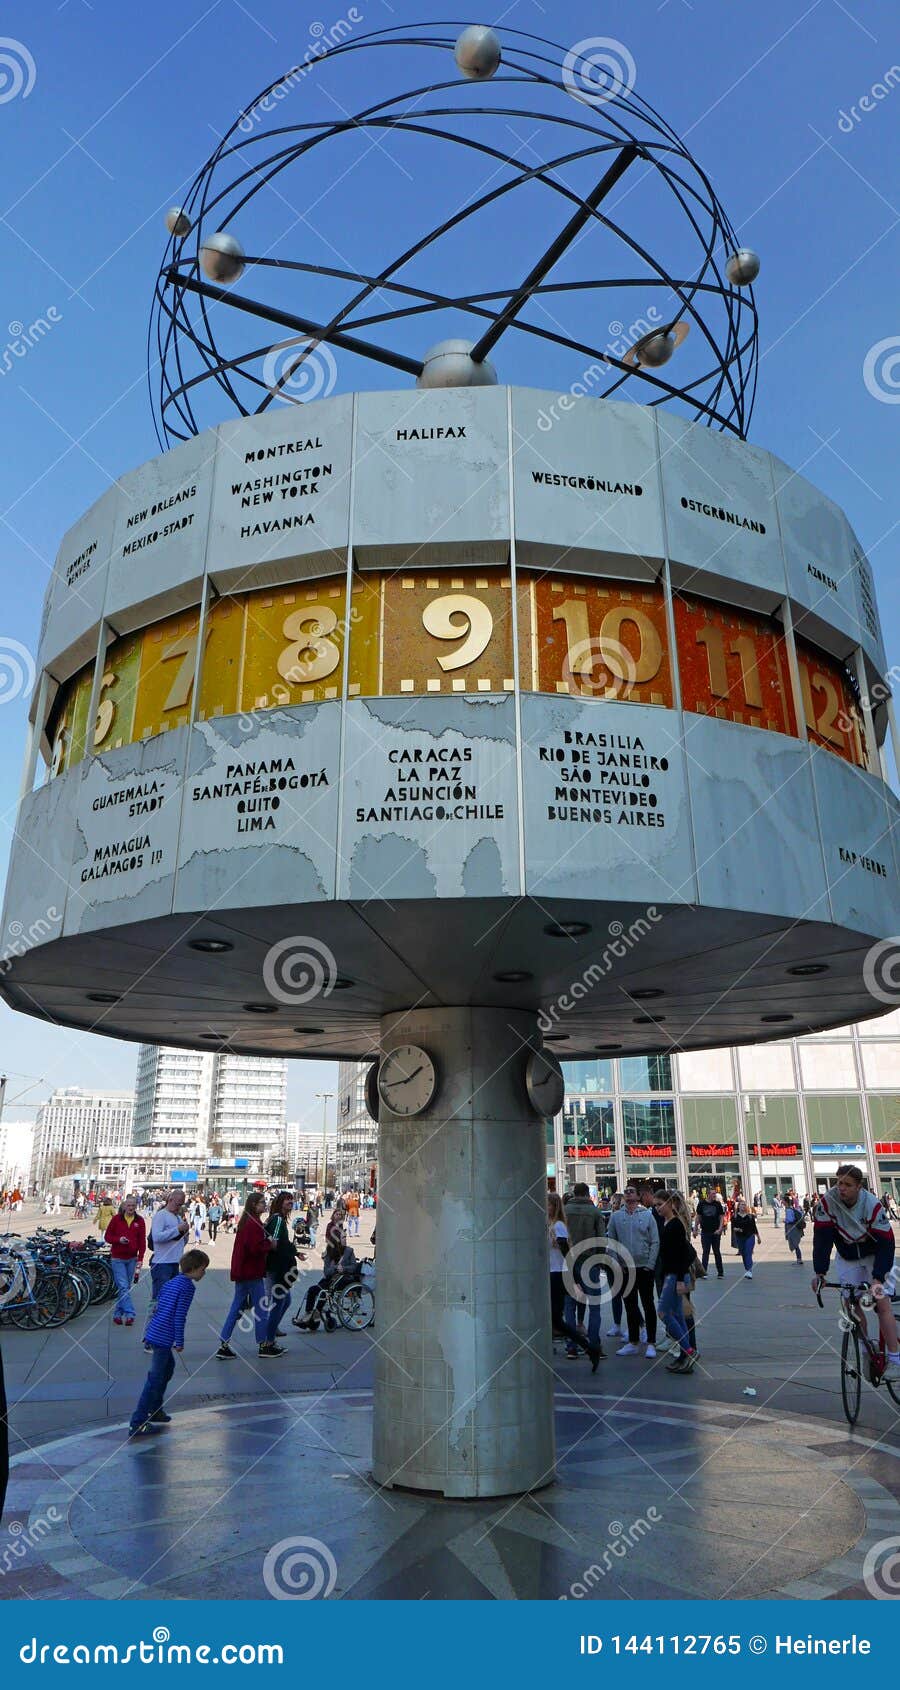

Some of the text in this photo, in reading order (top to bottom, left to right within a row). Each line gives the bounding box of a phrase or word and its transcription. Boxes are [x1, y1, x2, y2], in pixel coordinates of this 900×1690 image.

[397, 427, 466, 440] HALIFAX
[245, 437, 322, 463] MONTREAL
[231, 464, 333, 495] WASHINGTON
[532, 471, 643, 496] WESTGRÖNLAND
[127, 485, 196, 528] NEW ORLEANS
[242, 482, 319, 508] NEW YORK
[241, 513, 315, 538] HAVANNA
[680, 496, 766, 534] OSTGRÖNLAND
[122, 514, 195, 557] MEXIKO-STADT
[807, 563, 838, 592] AZOREN
[277, 605, 340, 683] 8
[422, 594, 493, 672] 9
[553, 599, 662, 683] 10
[160, 628, 213, 712] 7
[696, 624, 762, 709] 11
[564, 731, 644, 750] BRASILIA
[226, 758, 295, 778] PANAMA
[388, 748, 472, 763] CARACAS
[539, 747, 669, 771] RIO DE JANEIRO
[398, 767, 461, 782] LA PAZ
[560, 765, 650, 788] SÃO PAULO
[93, 780, 165, 812] GUATEMALA-
[384, 782, 476, 801] ASUNCIÓN
[555, 787, 658, 807] MONTEVIDEO
[128, 796, 164, 817] STADT
[237, 797, 280, 813] QUITO
[548, 806, 665, 827] BUENOS AIRES
[237, 816, 275, 832] LIMA
[94, 835, 151, 861] MANAGUA
[81, 852, 143, 882] GALÁPAGOS
[839, 847, 887, 877] KAP VERDE
